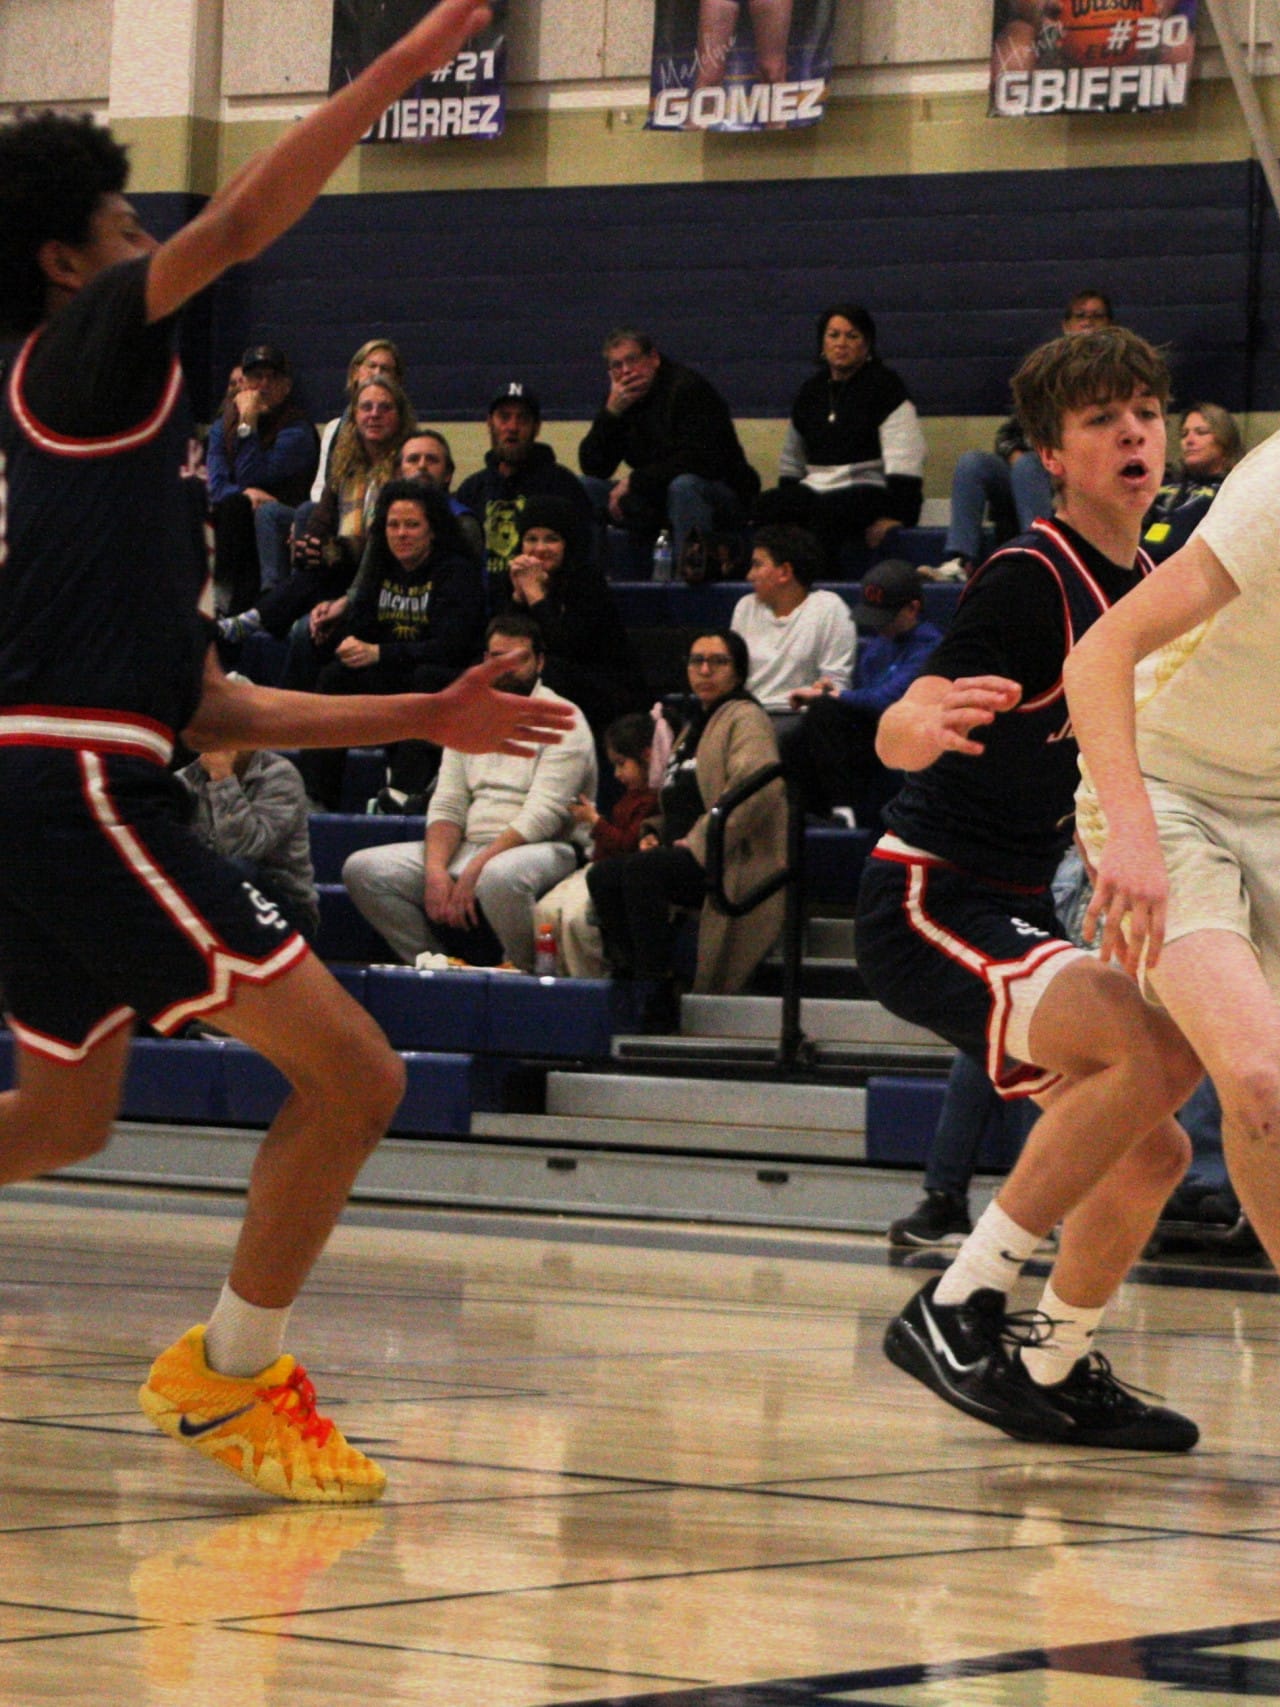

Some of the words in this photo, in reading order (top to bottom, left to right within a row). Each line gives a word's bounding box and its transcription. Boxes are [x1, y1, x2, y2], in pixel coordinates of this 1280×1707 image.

[1108, 16, 1188, 50] #30
[361, 96, 500, 139] TIERREZ
[653, 78, 825, 126] GOMEZ
